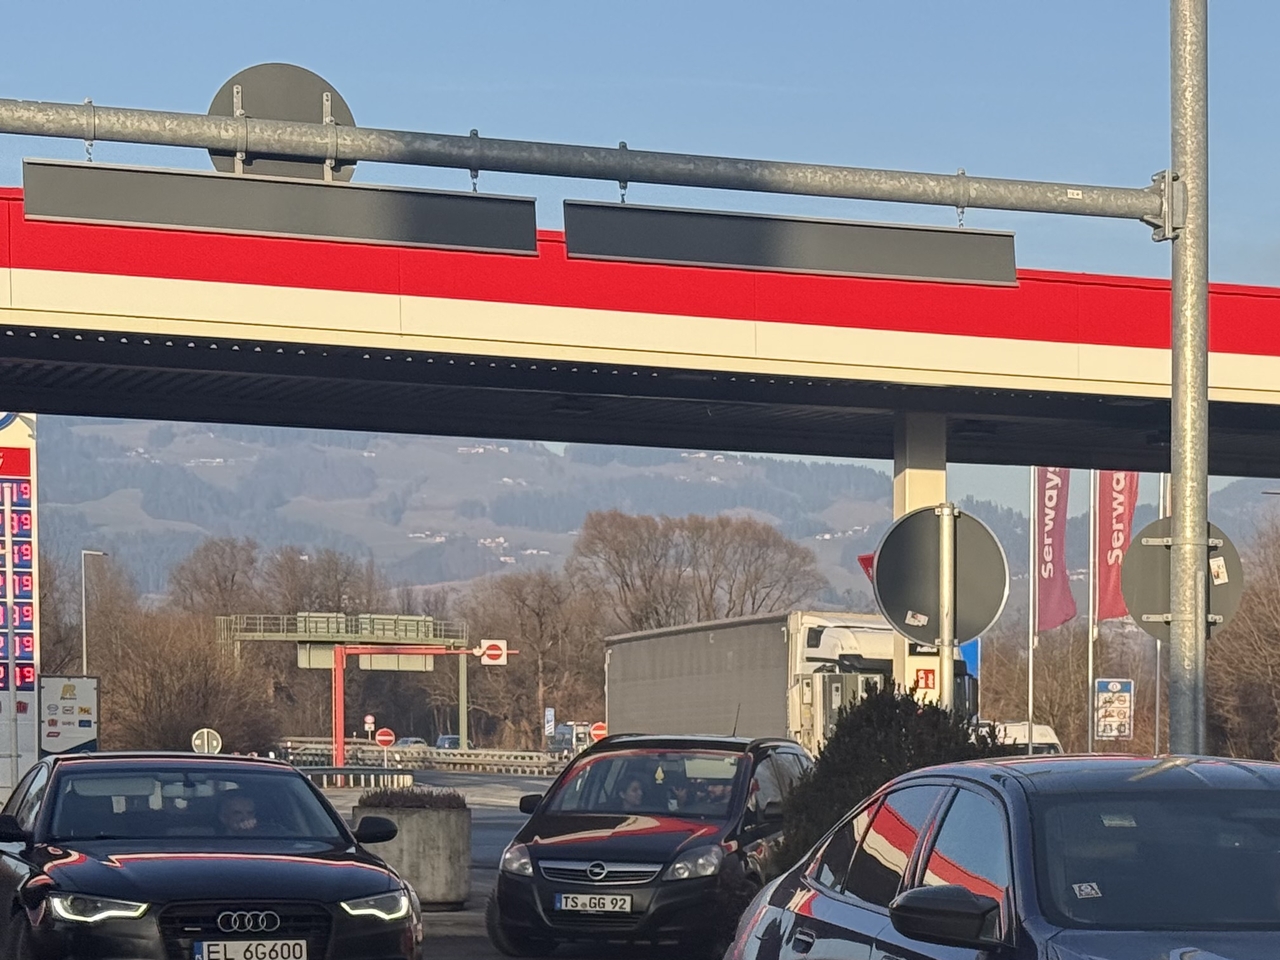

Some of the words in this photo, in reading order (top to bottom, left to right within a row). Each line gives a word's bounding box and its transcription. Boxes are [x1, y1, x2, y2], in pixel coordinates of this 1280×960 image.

[1107, 471, 1125, 565] Serwa
[563, 896, 579, 908] TS
[588, 897, 606, 909] GG
[610, 898, 627, 910] 92
[207, 943, 235, 960] EL
[243, 942, 303, 960] 6G600
